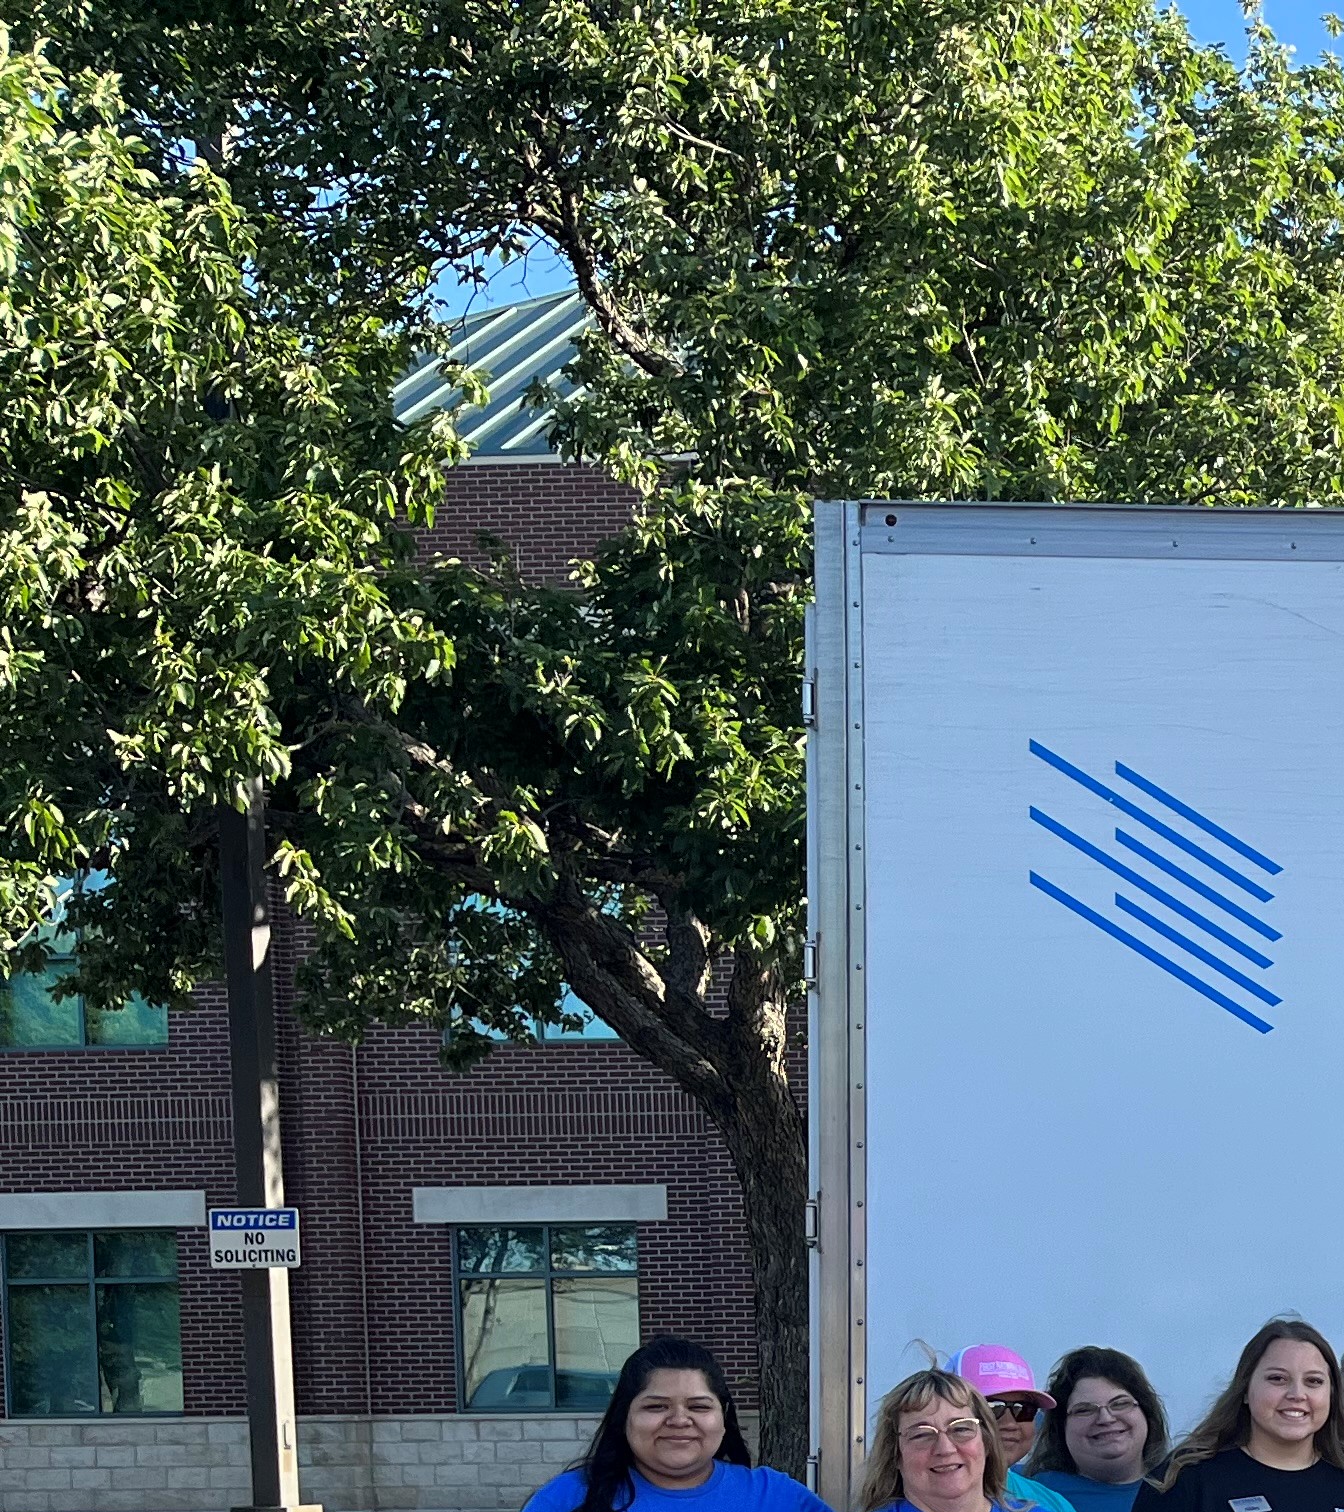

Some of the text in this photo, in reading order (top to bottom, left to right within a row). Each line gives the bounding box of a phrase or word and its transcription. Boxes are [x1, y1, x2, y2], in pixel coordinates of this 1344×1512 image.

[217, 1214, 291, 1227] NOTICE
[244, 1232, 265, 1246] NO
[214, 1249, 296, 1263] SOLICITING
